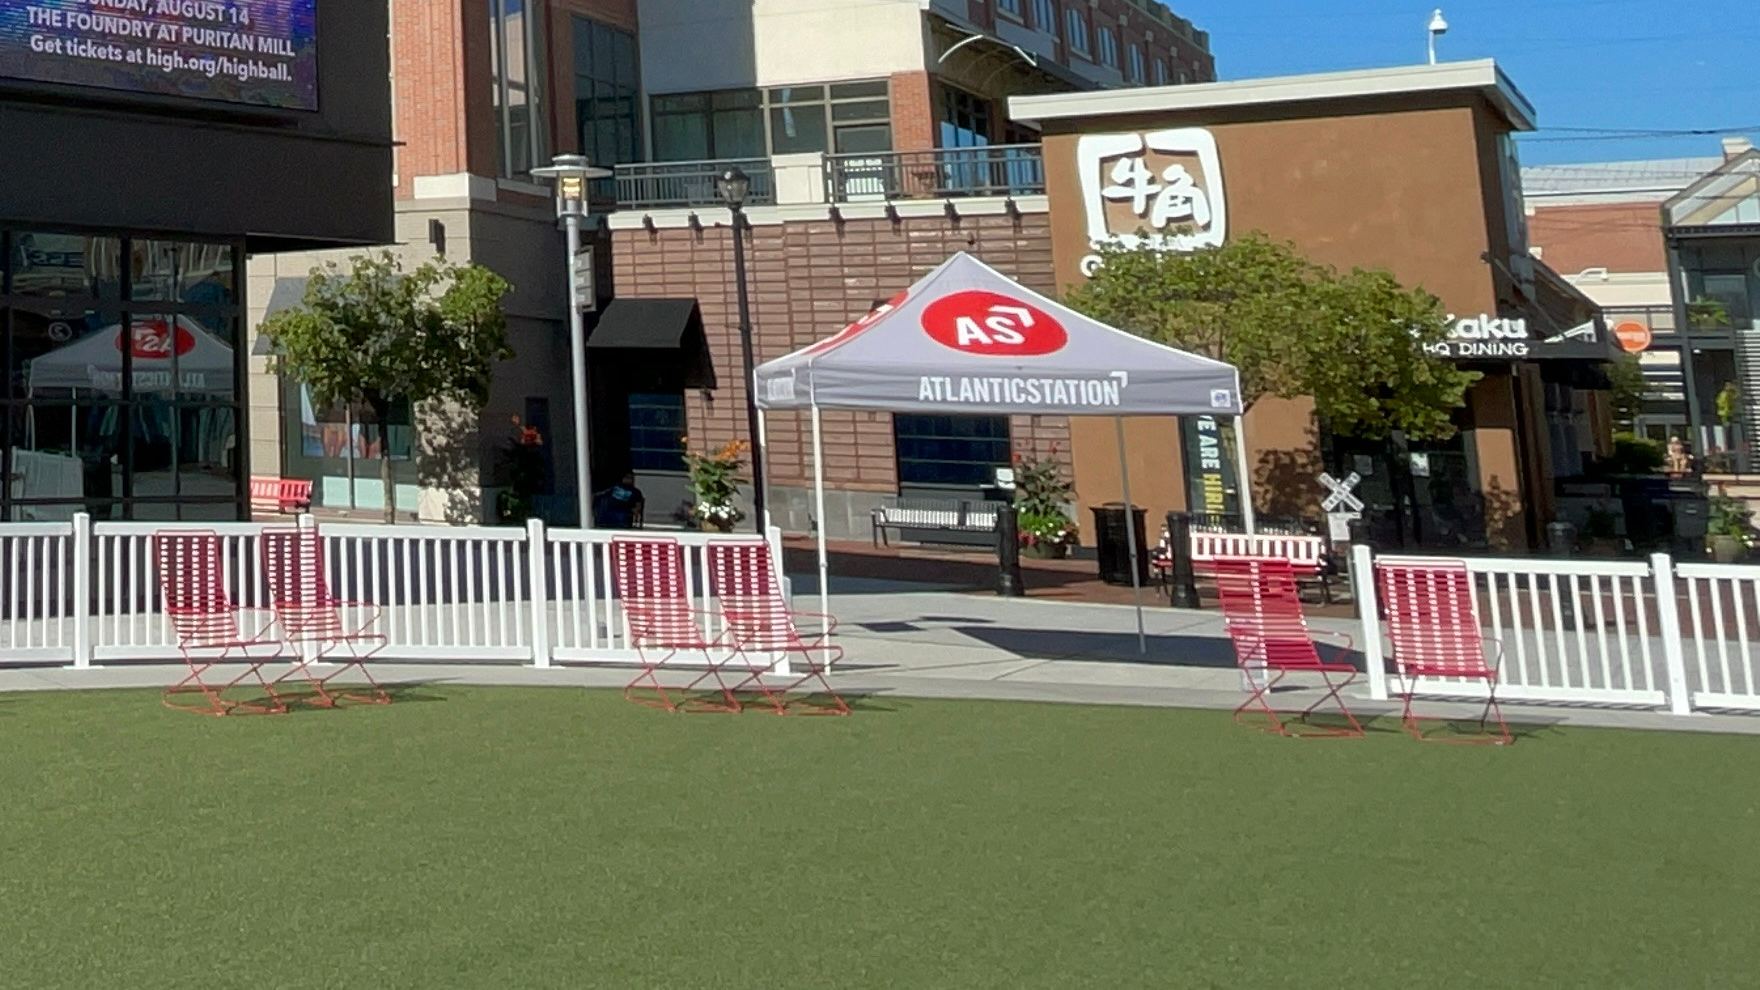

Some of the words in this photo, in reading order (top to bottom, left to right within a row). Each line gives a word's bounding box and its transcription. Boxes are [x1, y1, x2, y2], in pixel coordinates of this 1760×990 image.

[27, 6, 62, 28] THE
[66, 11, 154, 39] FOUNDRY
[156, 23, 179, 42] AT
[182, 28, 255, 52] PURITAN
[258, 36, 296, 58] MILL
[229, 7, 251, 26] 14
[30, 34, 62, 54] Get
[65, 36, 122, 62] tickets
[126, 46, 143, 64] at
[146, 49, 293, 82] high.org/highball.
[1102, 157, 1211, 228] 牛角
[956, 315, 1026, 346] AS
[1459, 341, 1530, 356] DINING
[918, 375, 1121, 406] ATLANTICSTATION
[1198, 434, 1220, 469] ARE
